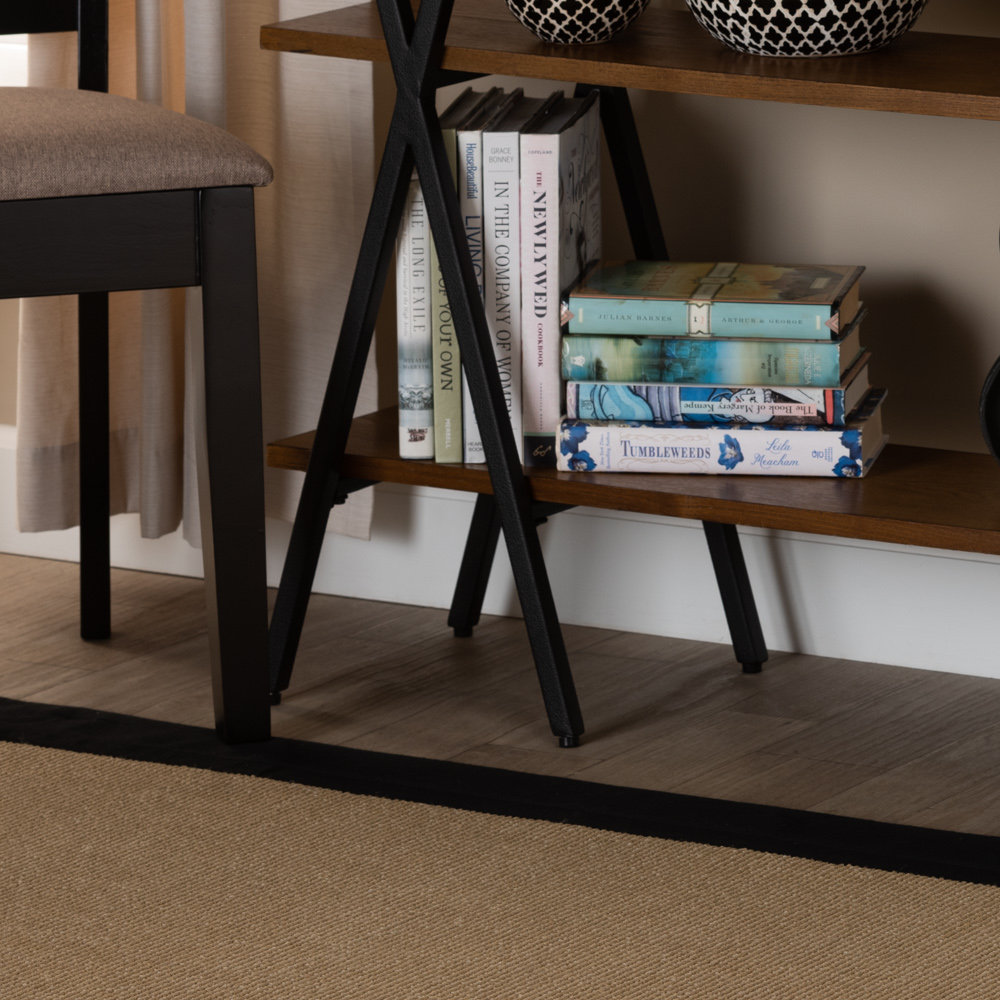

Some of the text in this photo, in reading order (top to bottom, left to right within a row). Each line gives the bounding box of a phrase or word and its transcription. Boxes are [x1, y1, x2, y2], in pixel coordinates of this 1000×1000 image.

[533, 191, 548, 319] NEWLYWED
[411, 198, 426, 333] THE LONG EXILE
[494, 180, 512, 351] IN THE COMPANY OF
[599, 313, 633, 321] JULIAN
[440, 351, 453, 391] OWN
[683, 402, 715, 413] Kempe
[717, 402, 753, 413] Margery
[768, 404, 793, 414] Book
[795, 404, 814, 415] The
[620, 440, 711, 459] TUMBLEWEEDS
[764, 437, 792, 455] Leila
[750, 454, 799, 469] Meacham
